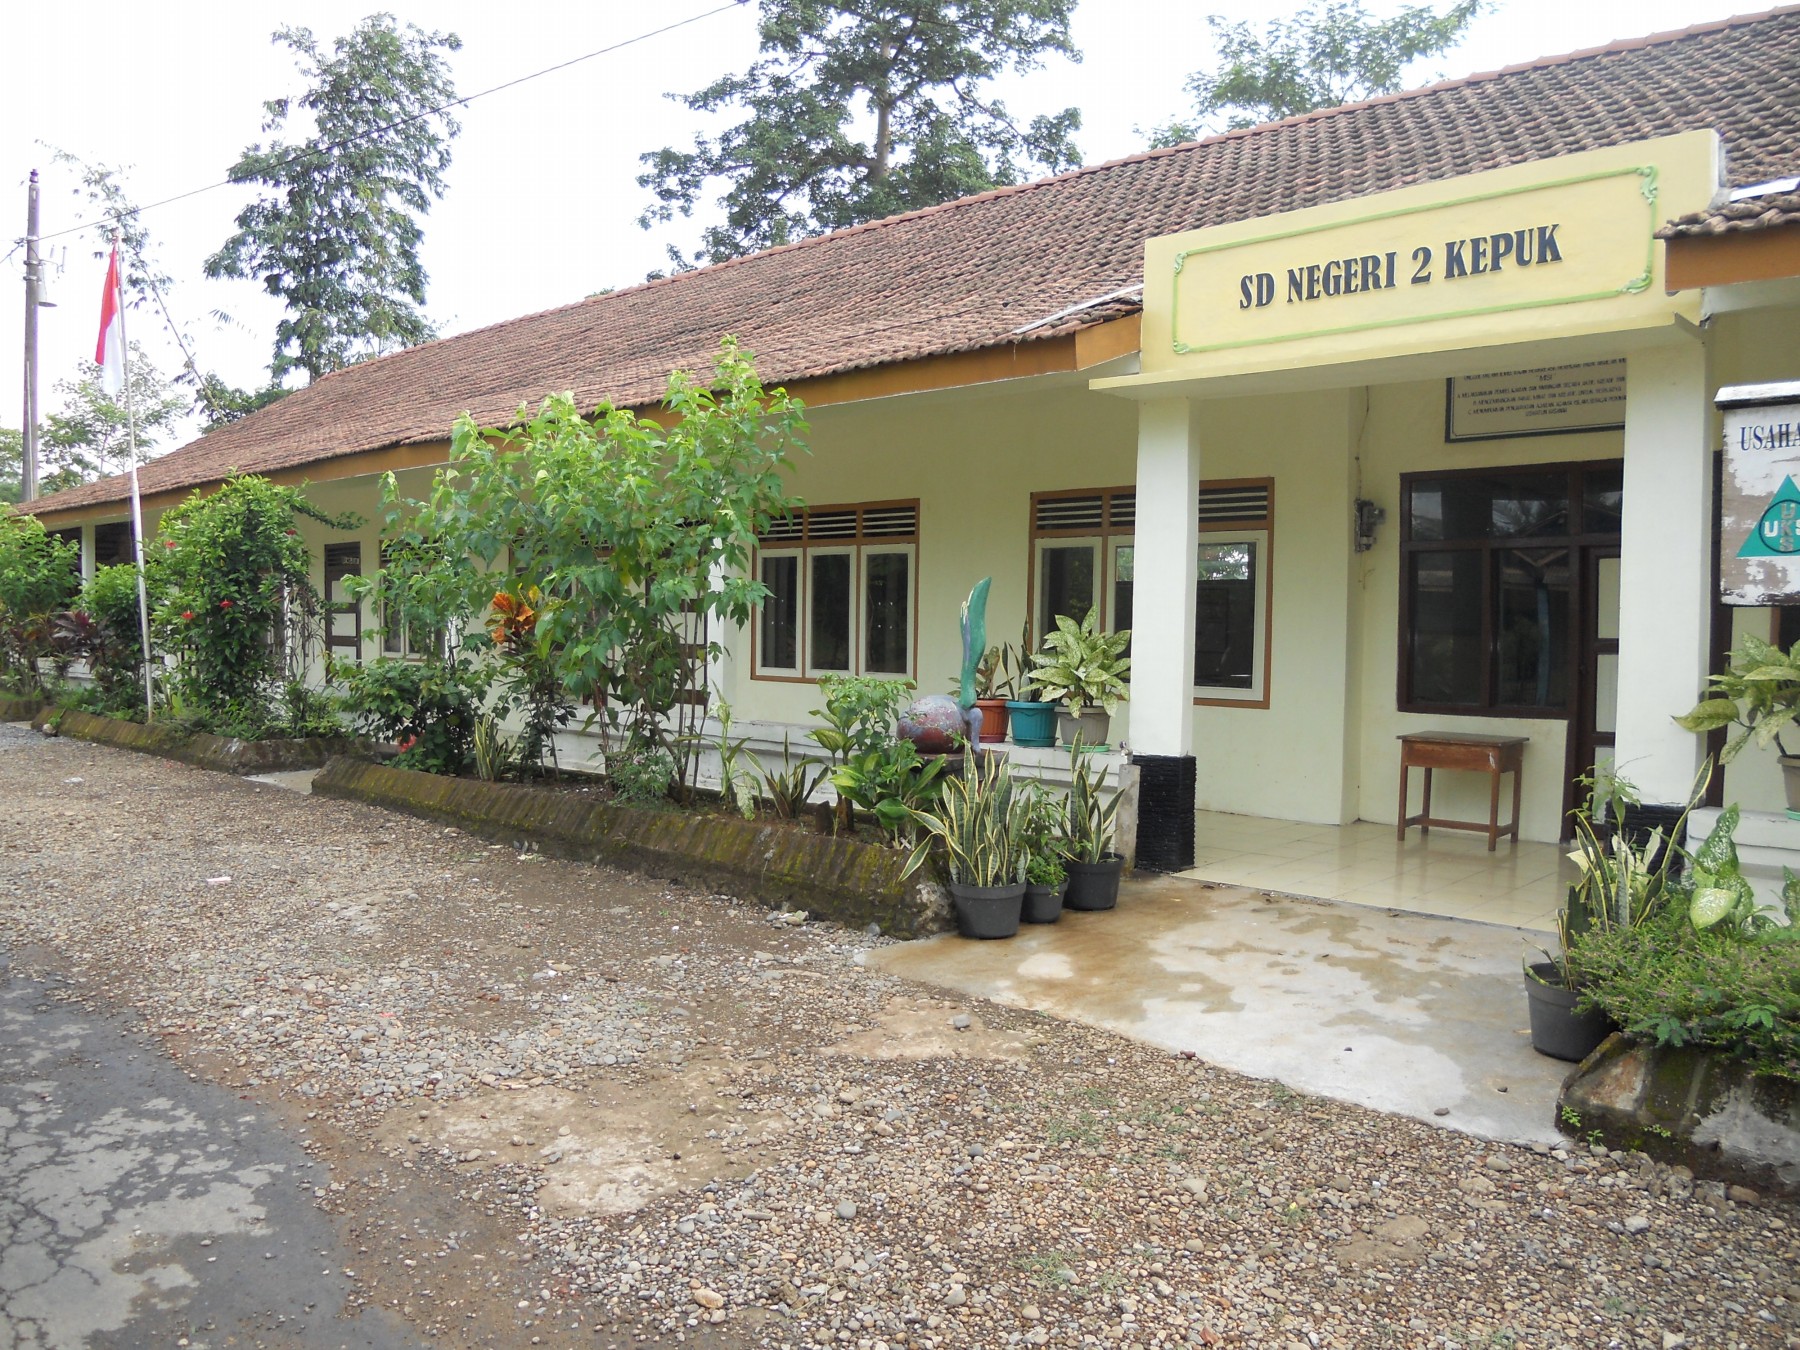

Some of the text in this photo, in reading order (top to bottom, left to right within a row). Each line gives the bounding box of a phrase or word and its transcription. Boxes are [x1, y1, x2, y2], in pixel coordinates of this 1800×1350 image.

[1239, 223, 1562, 310] SD NEGERI 2 KEPUK
